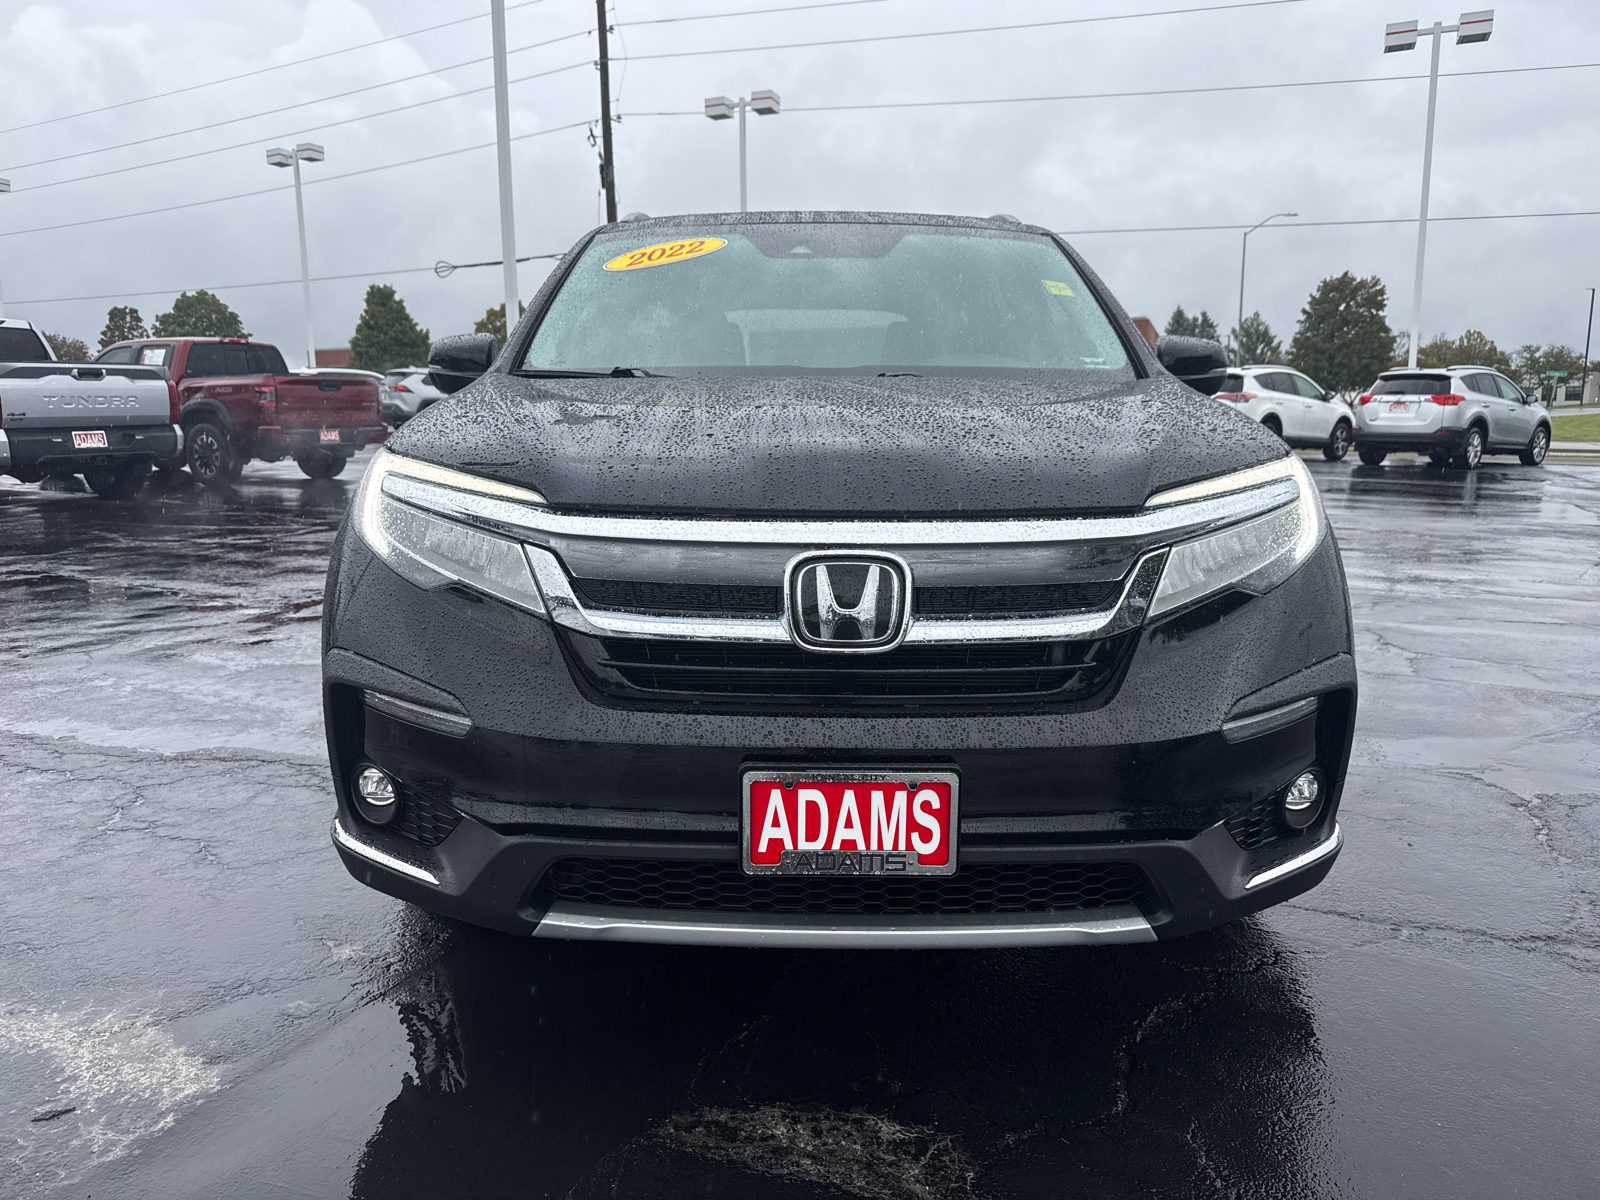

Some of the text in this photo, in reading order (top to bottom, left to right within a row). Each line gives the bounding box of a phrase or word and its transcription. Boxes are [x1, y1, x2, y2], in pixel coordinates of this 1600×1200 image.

[626, 240, 705, 268] 2022
[42, 395, 140, 408] TUNDRA
[76, 433, 105, 446] ADAMS
[320, 429, 340, 441] ADAMS
[812, 773, 887, 781] KANSAS CITY
[757, 788, 941, 855] ADAMS
[793, 853, 907, 872] ADAMS
